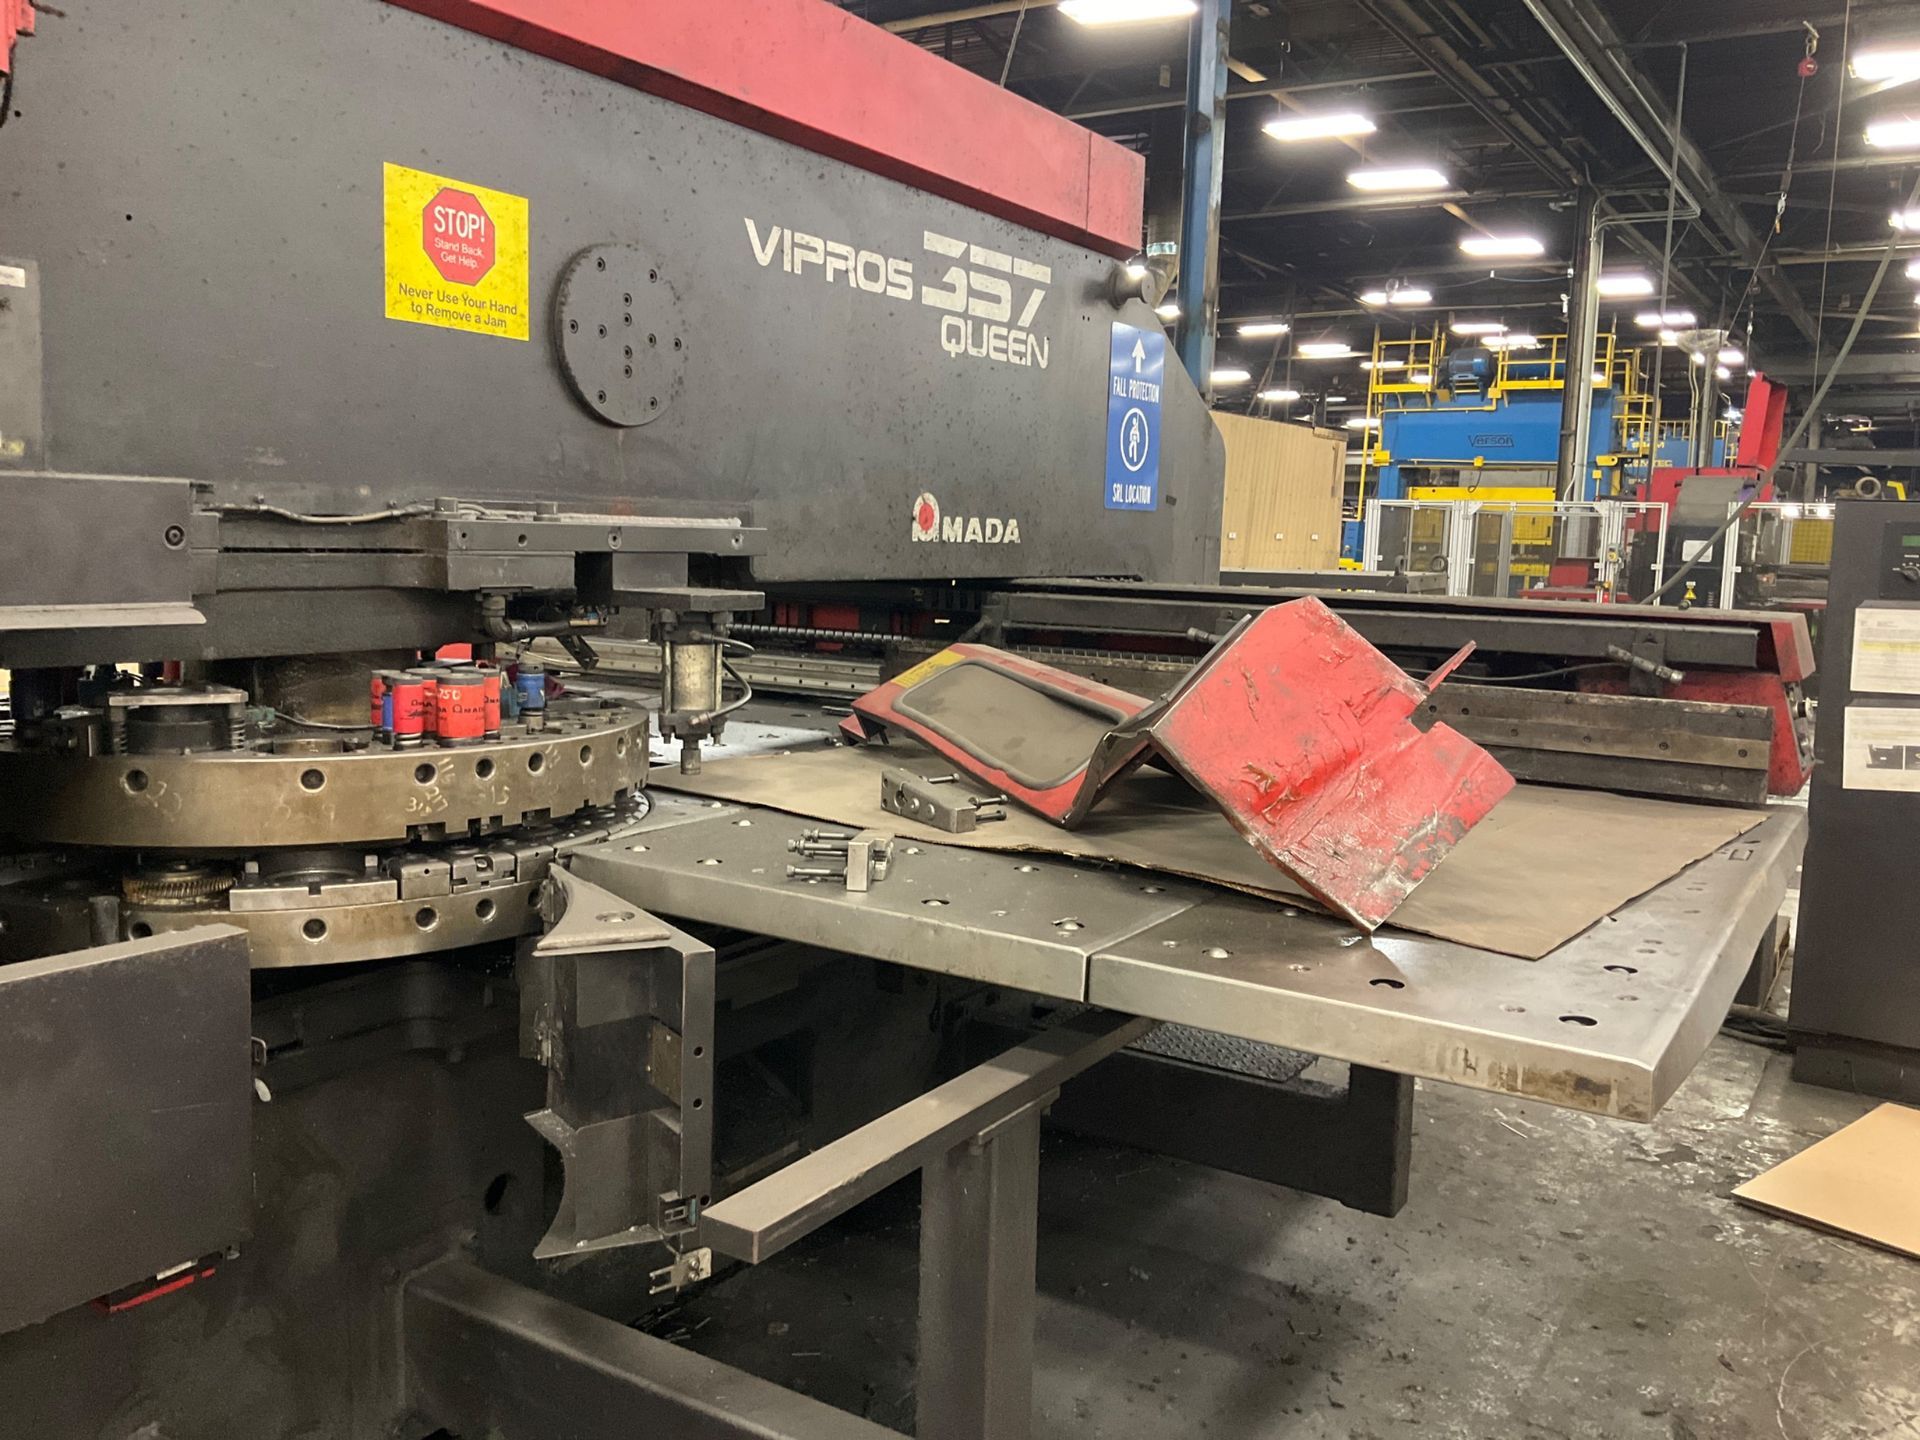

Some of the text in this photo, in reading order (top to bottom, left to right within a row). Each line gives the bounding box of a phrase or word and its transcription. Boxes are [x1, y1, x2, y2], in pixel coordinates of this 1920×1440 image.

[434, 205, 485, 243] STOP!
[434, 237, 460, 252] Stand
[440, 251, 456, 264] Get
[744, 218, 1052, 329] VIPROS 357
[399, 283, 518, 316] Never Use Your Hand
[411, 301, 508, 329] to Remove a Jam
[941, 315, 1049, 369] QUEEN
[1113, 376, 1160, 403] FALL PROTECTION
[1112, 483, 1152, 505] SRL LOCATION
